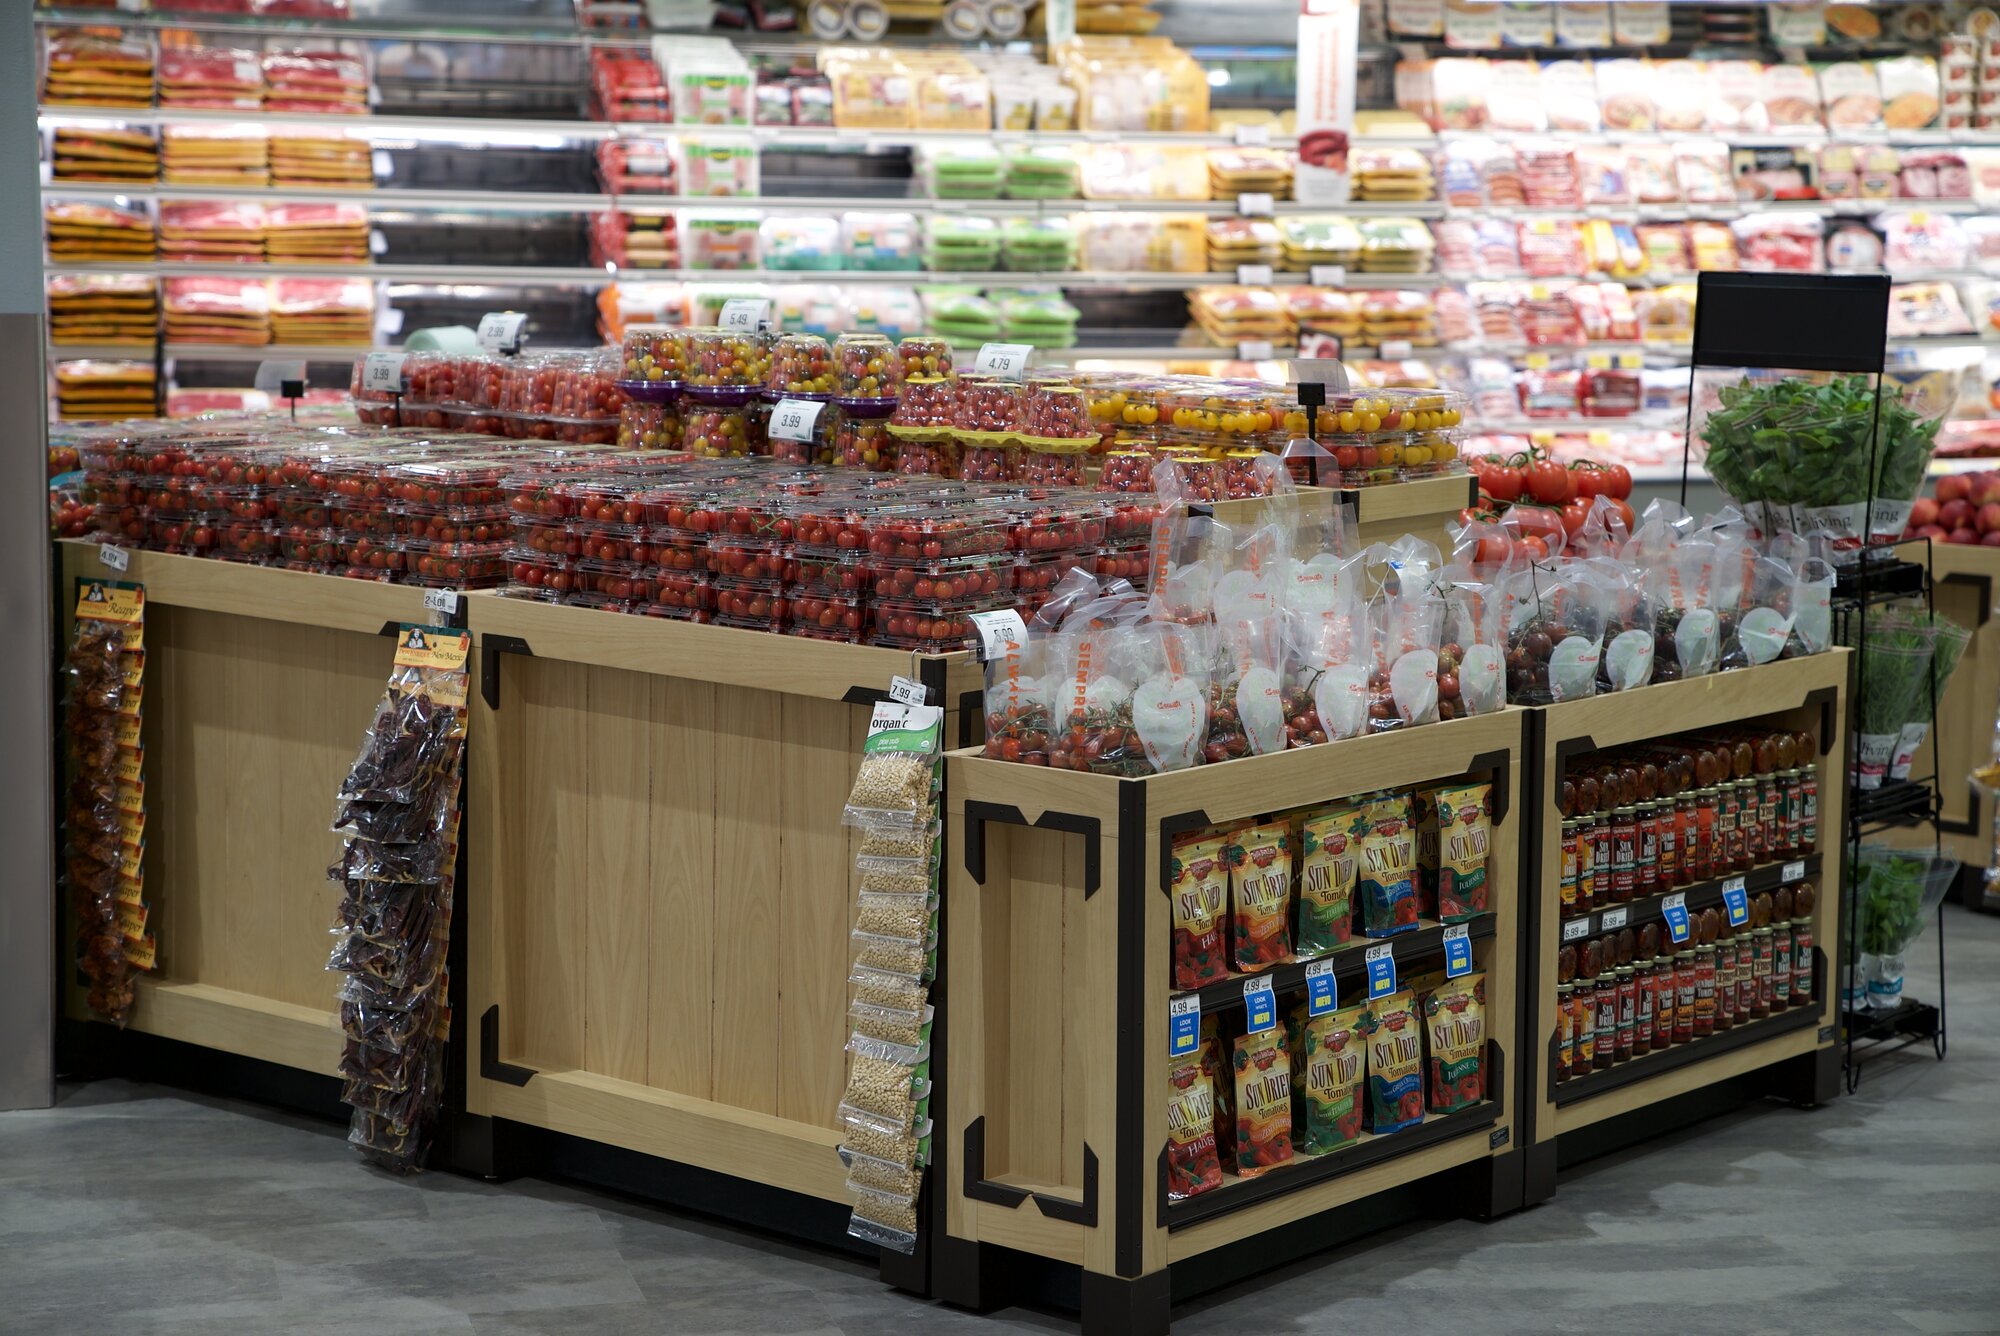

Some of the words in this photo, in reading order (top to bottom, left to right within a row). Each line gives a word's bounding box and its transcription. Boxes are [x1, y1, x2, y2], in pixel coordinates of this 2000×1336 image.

[729, 314, 748, 326] 5.49
[487, 326, 505, 338] 2.99
[988, 357, 1011, 371] 4.79
[372, 368, 389, 381] 3.99
[780, 414, 801, 428] 3.99
[1834, 539, 1849, 549] ASIL
[1871, 536, 1887, 545] ASIL
[1155, 526, 1171, 595] SIEMPRE
[108, 602, 141, 617] Reaper
[1073, 642, 1092, 717] SIEMPRE
[891, 684, 911, 700] 7.99
[872, 718, 908, 732] organc
[1450, 835, 1470, 861] SUN
[1620, 841, 1632, 852] SUN
[1366, 847, 1389, 873] SUN
[1616, 850, 1633, 863] DRIED
[1308, 864, 1331, 892] SUN
[1784, 870, 1795, 880] 6.99
[1243, 878, 1264, 906] SUN
[1603, 917, 1617, 927] 6.99
[1444, 927, 1458, 939] 4.99
[1565, 927, 1579, 937] 6.99
[1366, 947, 1381, 960] 4.99
[1306, 964, 1321, 976] 4.99
[1244, 980, 1260, 992] 4.99
[1172, 1002, 1188, 1014] 4.99
[1455, 1019, 1481, 1046] DRIED
[1376, 1042, 1394, 1069] SUN
[1311, 1062, 1335, 1090] SUN
[1388, 1063, 1417, 1078] Tomatoes
[1245, 1083, 1266, 1111] SUN
[1185, 1092, 1212, 1122] DRIE
[1259, 1102, 1289, 1120] Tomatoes
[1188, 1135, 1215, 1157] HALVES
